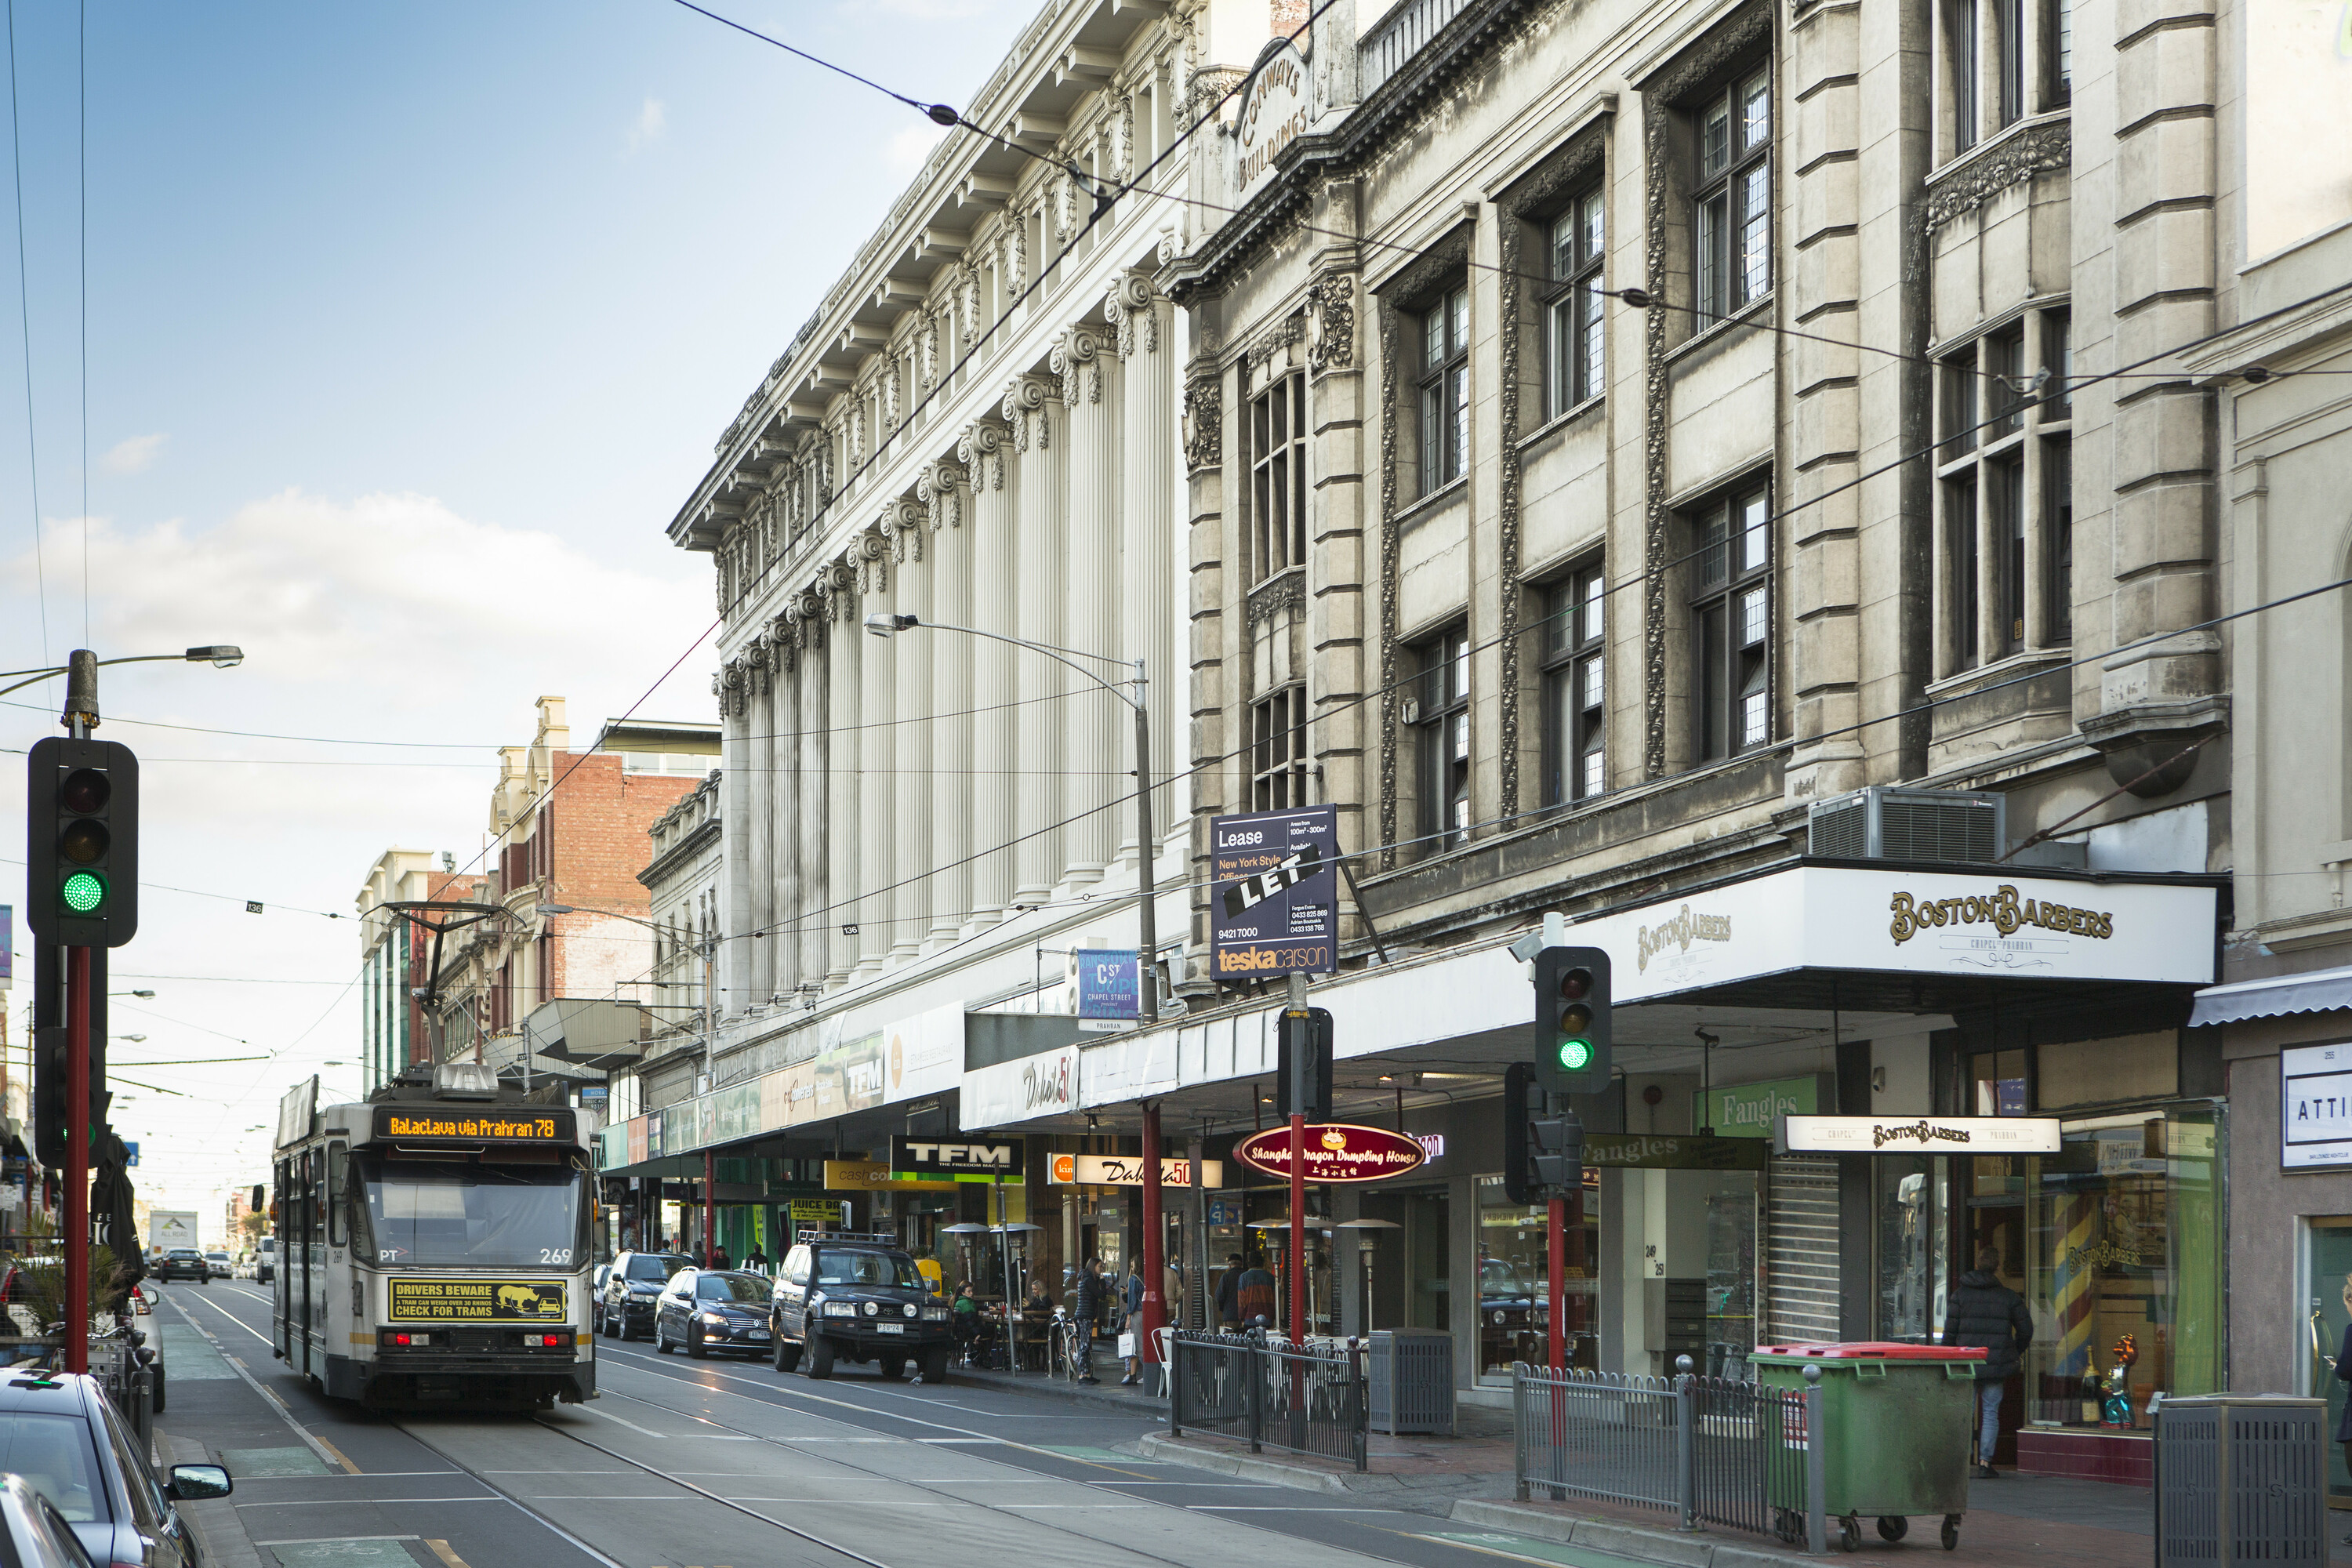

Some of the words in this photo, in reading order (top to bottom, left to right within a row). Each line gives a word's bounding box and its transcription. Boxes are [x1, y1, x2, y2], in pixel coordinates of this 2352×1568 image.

[1243, 58, 1300, 147] CONWAYS
[1239, 105, 1307, 192] BUILDINGS
[1218, 830, 1263, 848] Lease
[1219, 860, 1238, 869] New
[1239, 857, 1258, 868] York
[1259, 854, 1282, 866] Style
[1240, 853, 1301, 909] LET
[247, 903, 263, 913] 136
[1889, 891, 1997, 947] BOSTON
[1994, 884, 2114, 940] BARBERS
[844, 926, 858, 935] 136
[1218, 929, 1236, 939] 9421
[1236, 927, 1258, 938] 7000
[1637, 916, 1683, 976] BOSTON
[1679, 903, 1732, 955] BARBERS
[1970, 938, 1997, 949] CHAPEL
[1218, 946, 1328, 972] teskacarson
[2325, 1051, 2335, 1060] 255
[847, 1058, 882, 1094] TFM
[1722, 1091, 1798, 1127] Fangles
[2298, 1097, 2352, 1121] ATTI
[390, 1117, 456, 1135] Balaclava
[458, 1119, 477, 1136] via
[480, 1120, 532, 1137] Prahran
[535, 1119, 554, 1137] 78
[1872, 1124, 1919, 1149] BOSTON
[1918, 1120, 1971, 1144] BARBERS
[906, 1142, 1011, 1164] TFM
[1252, 1147, 1292, 1163] Shangha
[1336, 1149, 1384, 1165] Dumpling
[1386, 1149, 1417, 1163] House
[1582, 1137, 1680, 1163] Fangles
[1102, 1160, 1191, 1184] Dakta50
[793, 1200, 822, 1209] JUICE
[826, 1200, 841, 1210] BA
[333, 1250, 343, 1264] 269
[379, 1249, 398, 1261] PT
[540, 1248, 572, 1265] 269
[1646, 1245, 1657, 1258] 249
[2068, 1246, 2101, 1276] BOSTON
[2099, 1240, 2142, 1270] BARBERS
[1655, 1263, 1664, 1276] 251
[396, 1284, 443, 1295] DRIVERS
[445, 1285, 492, 1296] BEWARE
[396, 1306, 430, 1316] CHECK
[433, 1306, 453, 1316] FOR
[456, 1306, 492, 1316] TRAMS
